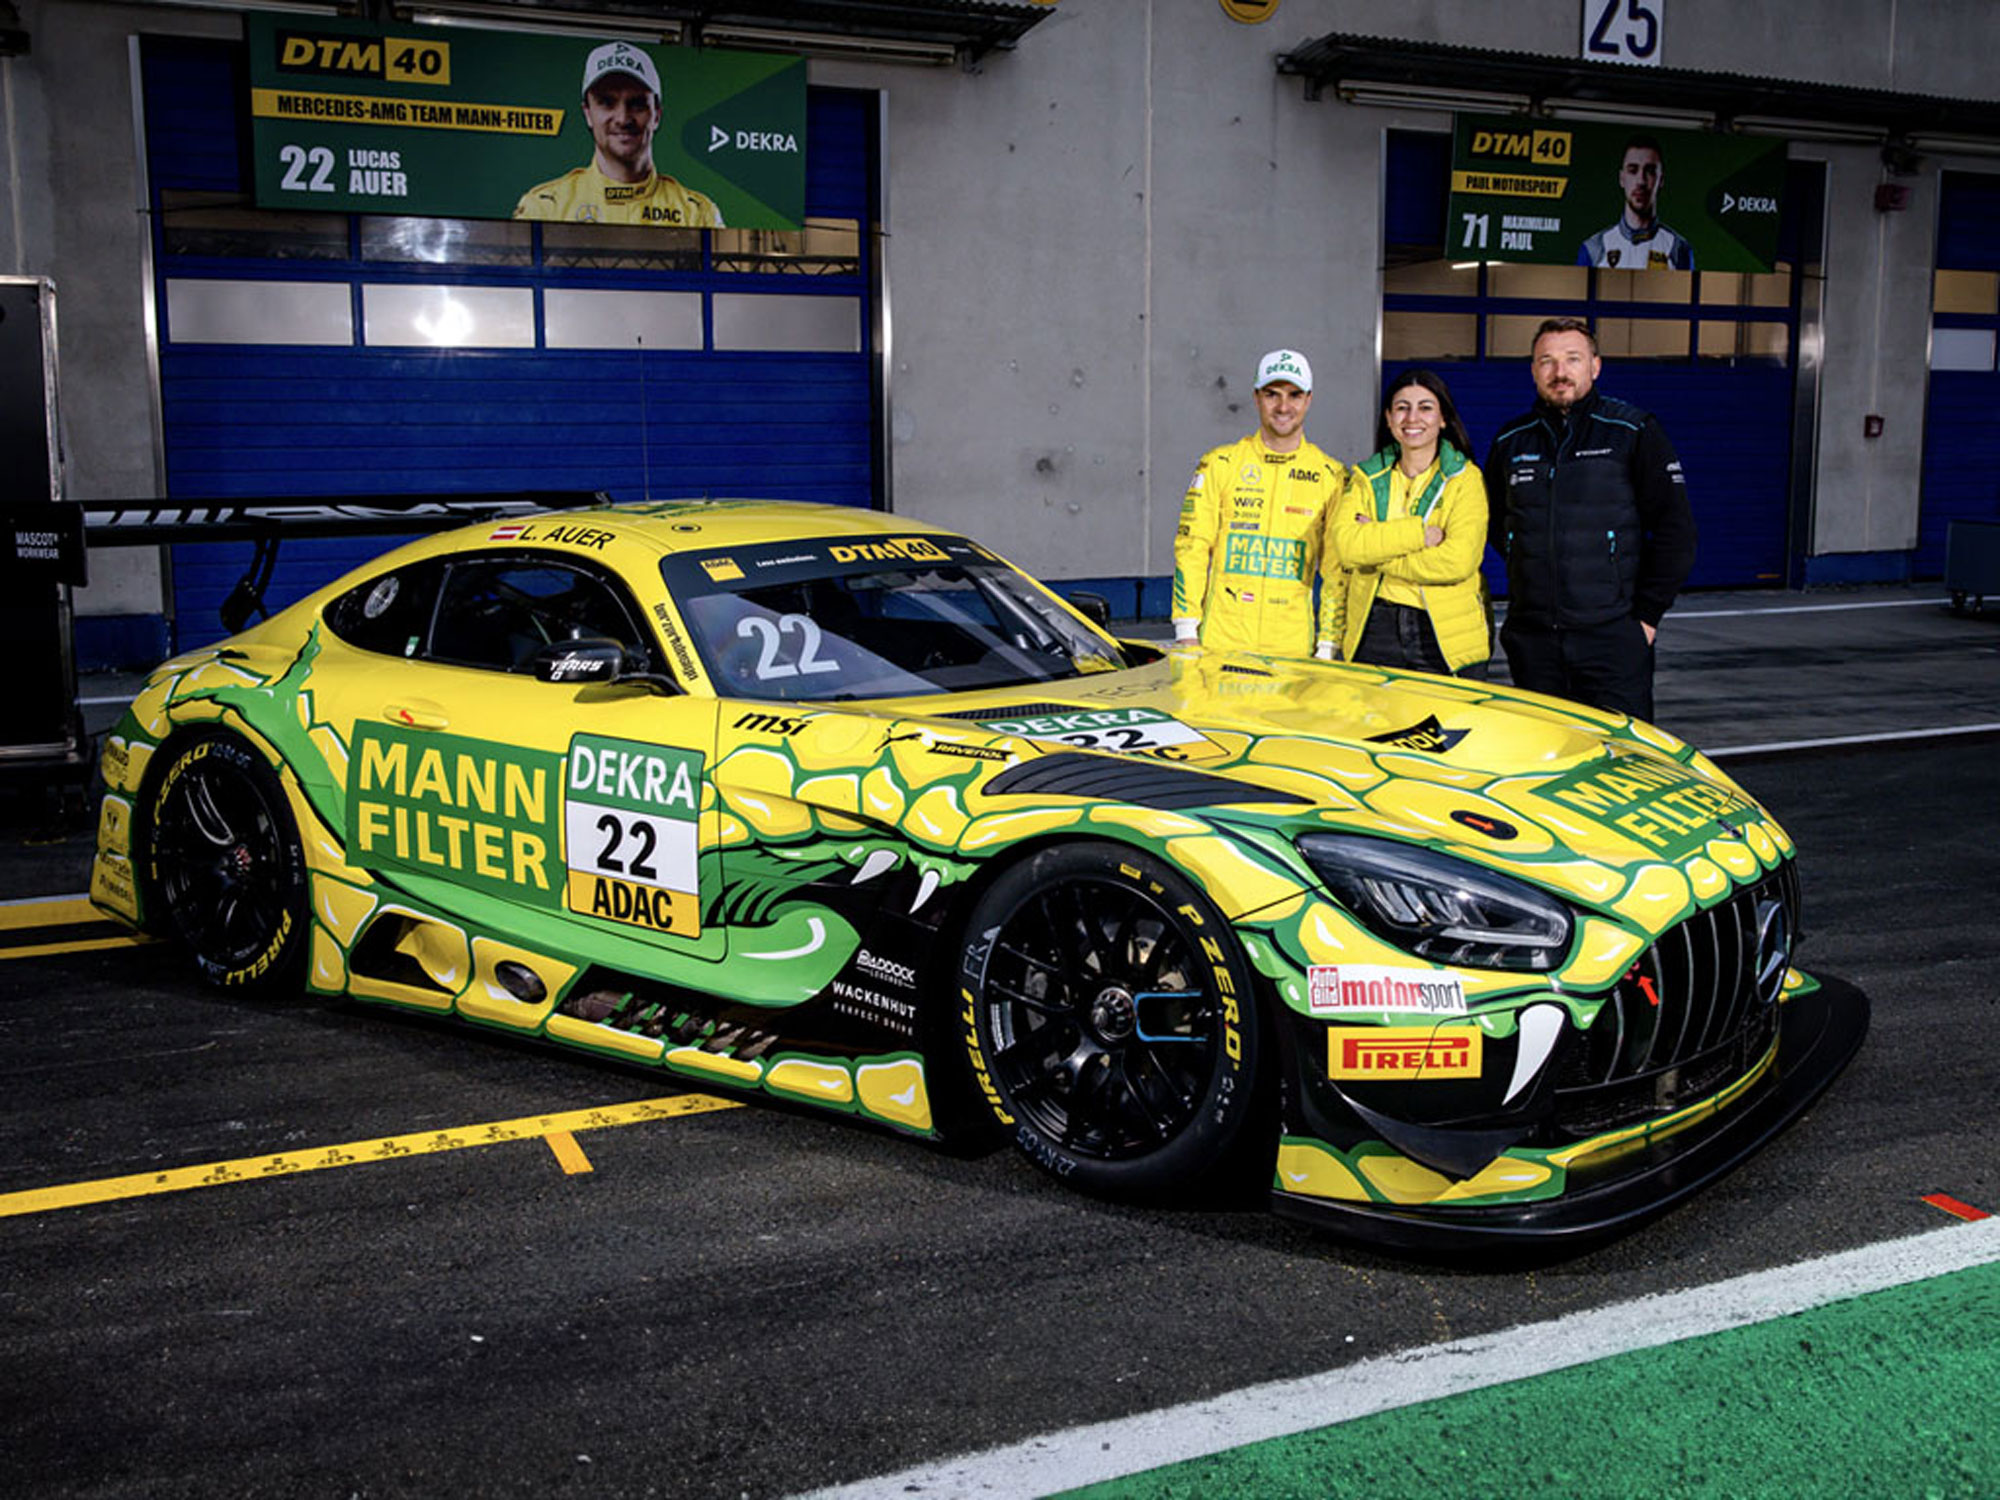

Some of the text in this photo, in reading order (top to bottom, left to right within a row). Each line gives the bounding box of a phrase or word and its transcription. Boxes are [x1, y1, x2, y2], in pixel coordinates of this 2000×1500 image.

[1588, 0, 1658, 58] 25
[281, 37, 442, 76] DTM 40
[597, 55, 646, 75] DEKRA
[277, 94, 554, 131] MERCEDES-AMG TEAM MANN-FILTER
[736, 130, 799, 153] DEKRA
[1471, 131, 1566, 159] DTM 40
[280, 144, 336, 192] 22
[348, 149, 401, 170] LUCAS
[349, 169, 408, 197] AUER
[1465, 174, 1559, 195] PAUL MOTORSPORT
[642, 206, 682, 223] ADAC
[1738, 197, 1778, 213] DEKRA
[1462, 212, 1489, 248] 71
[1500, 231, 1534, 251] PAUL
[1265, 363, 1301, 376] DEKRA
[1288, 467, 1321, 484] ADAC
[518, 525, 616, 550] L. AUER
[828, 542, 904, 563] DTM
[906, 540, 937, 557] 40
[1231, 535, 1301, 559] MANN
[1228, 554, 1299, 577] FILTER
[736, 612, 841, 681] 22
[733, 702, 814, 736] msi
[986, 709, 1166, 736] DEKRA
[358, 737, 547, 825] MANN
[570, 744, 696, 810] DEKRA
[1553, 759, 1691, 816] MANN
[358, 800, 550, 891] FILTER
[596, 813, 658, 881] 22
[592, 877, 674, 929] ADAC
[225, 908, 292, 986] PIRELLI
[832, 980, 917, 1019] WACKENHUT
[1177, 903, 1204, 927] P
[1199, 936, 1242, 1064] ZERO
[961, 987, 1016, 1126] PIRELLI
[1341, 1036, 1471, 1070] PIRELLI
